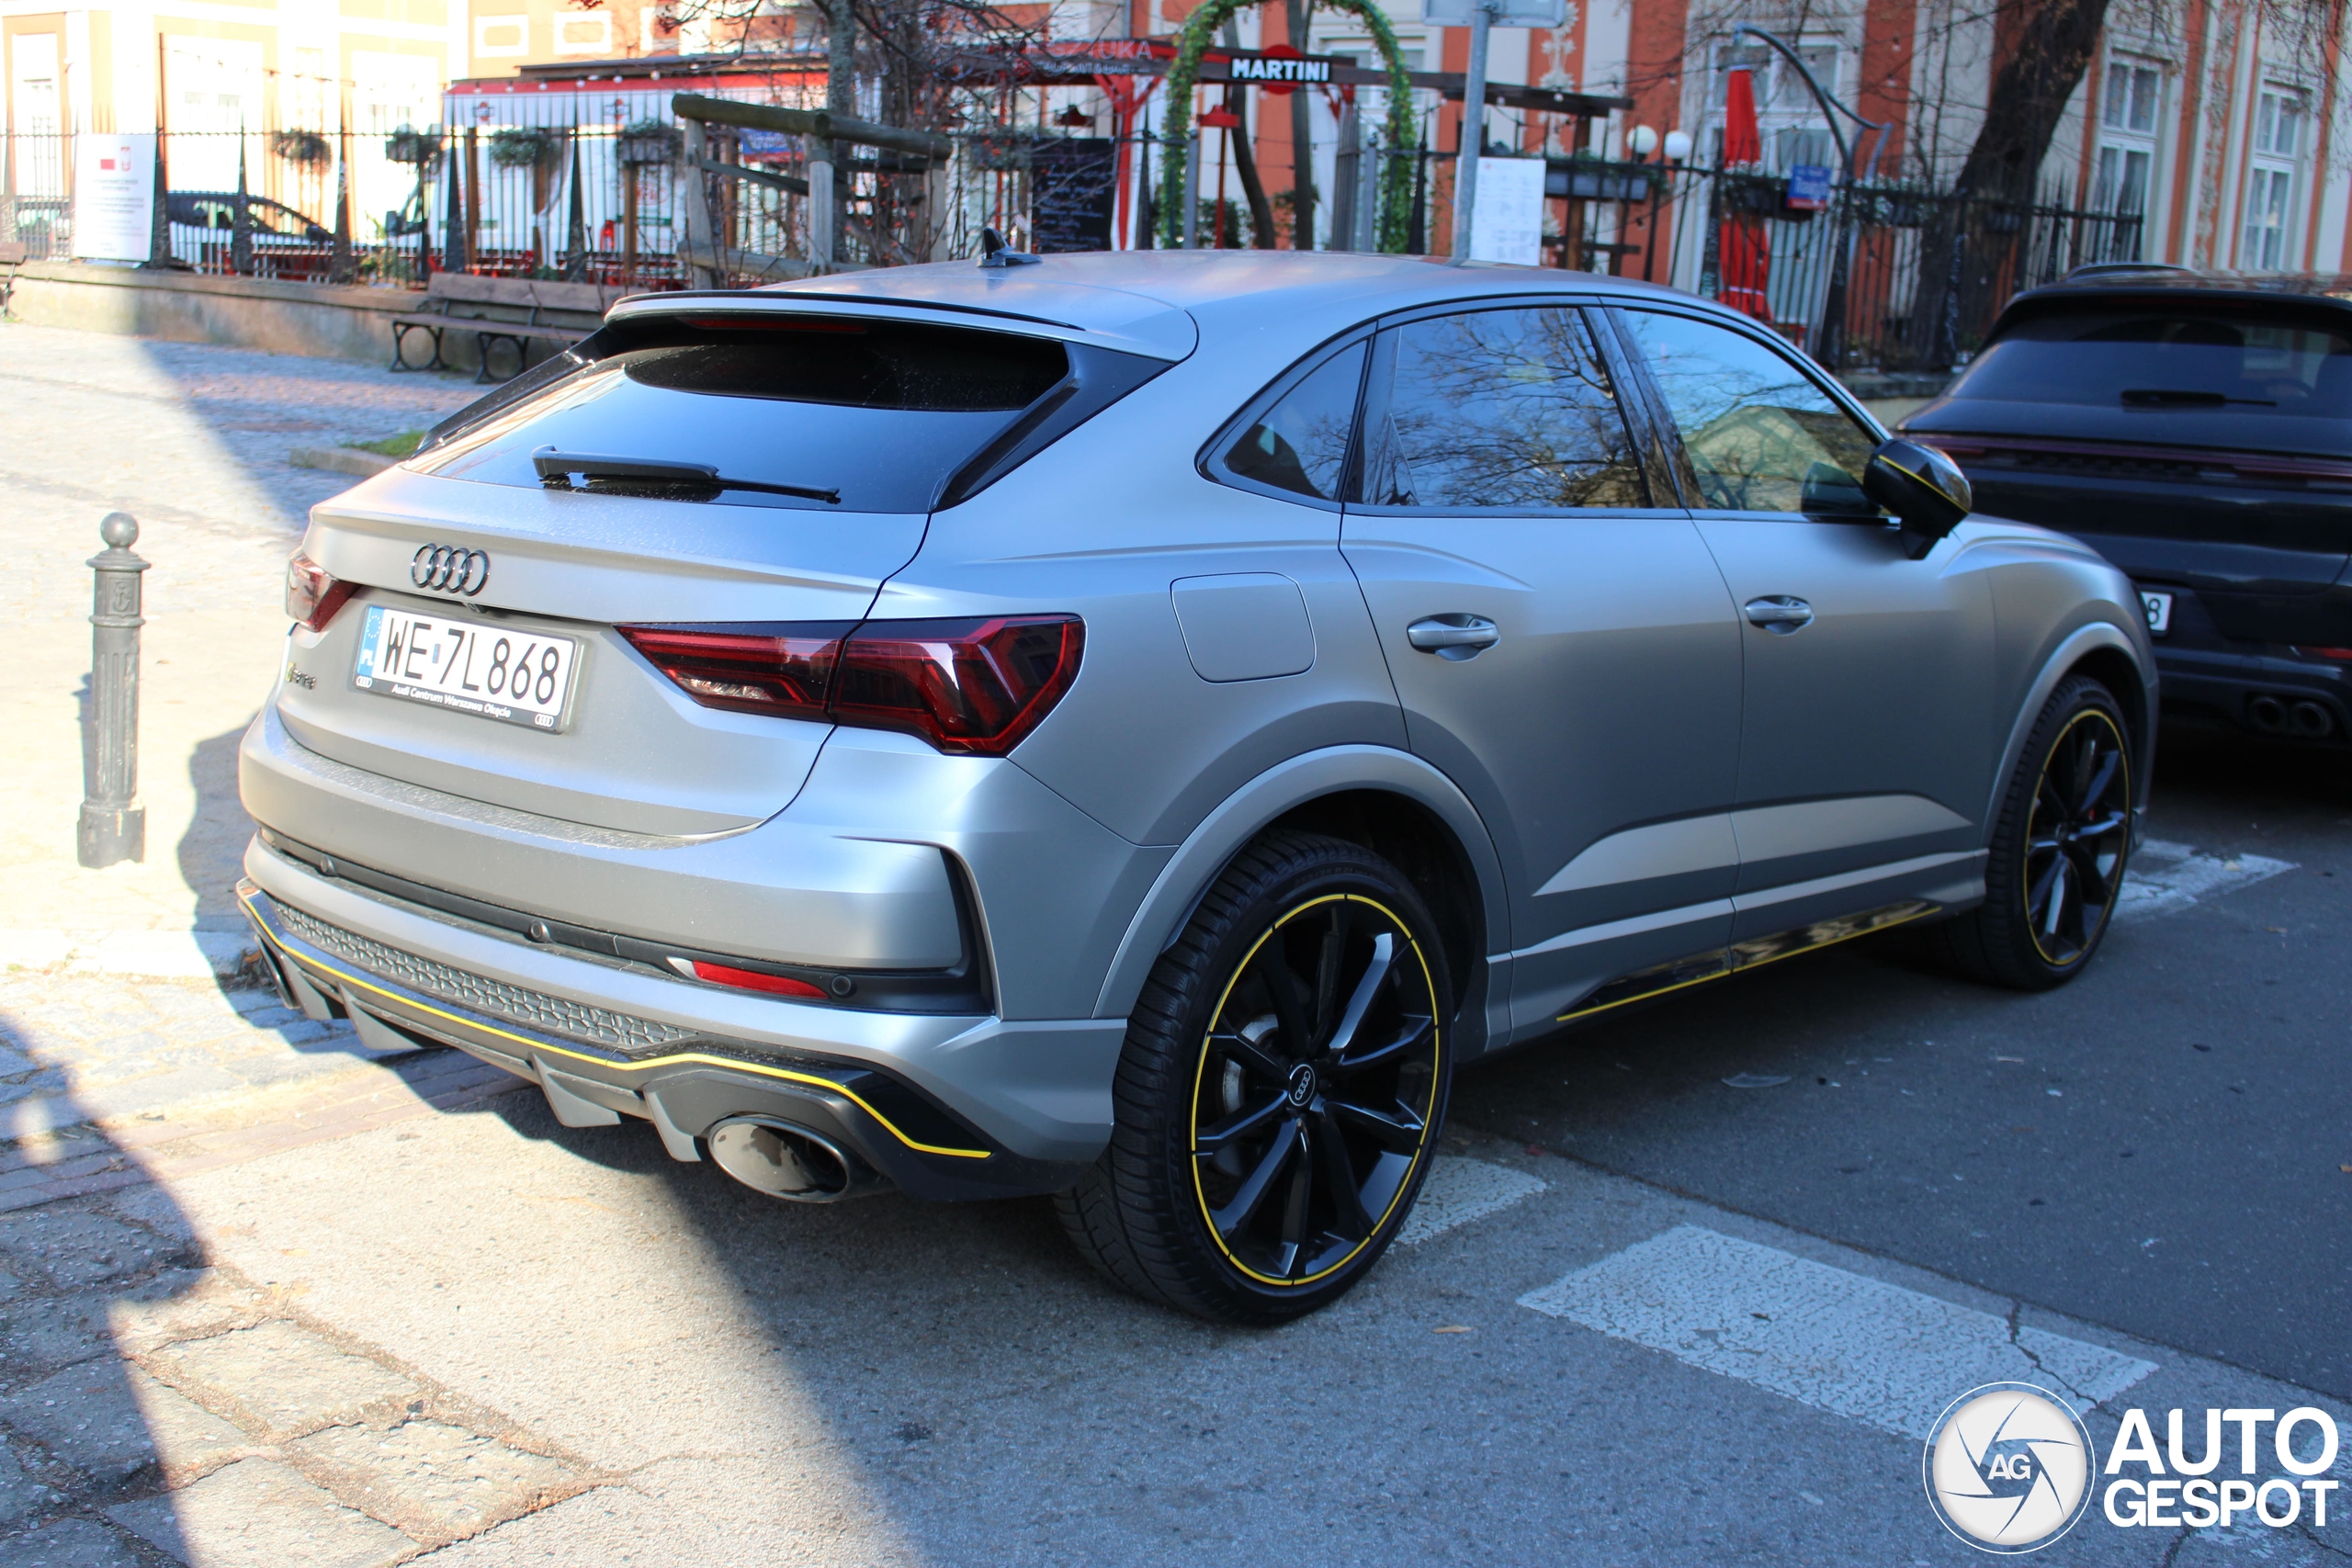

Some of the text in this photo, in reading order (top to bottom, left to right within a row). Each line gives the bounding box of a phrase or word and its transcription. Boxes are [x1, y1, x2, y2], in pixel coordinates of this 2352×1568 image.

[1231, 58, 1329, 82] MARTINI
[360, 649, 374, 667] PL
[383, 617, 432, 680] WE
[438, 628, 560, 705] 7L868
[391, 683, 512, 719] Audi Centrum Warszawa Okęcie
